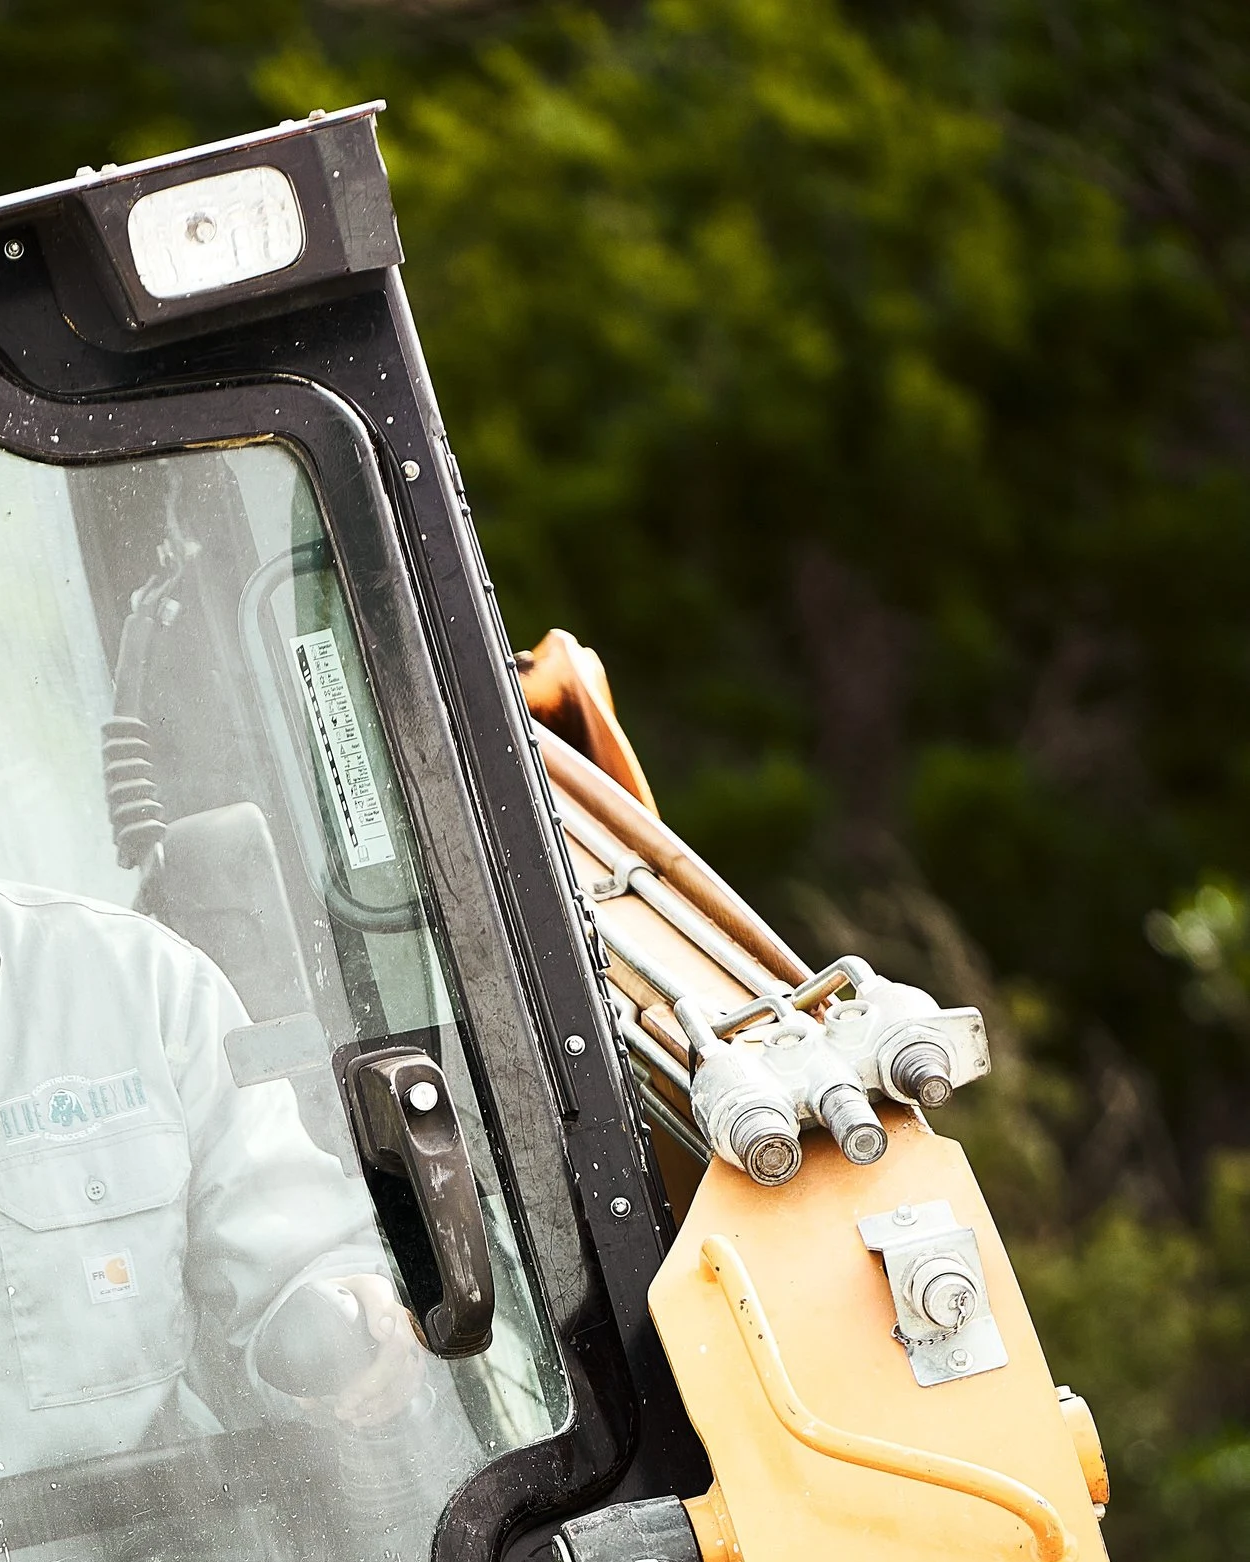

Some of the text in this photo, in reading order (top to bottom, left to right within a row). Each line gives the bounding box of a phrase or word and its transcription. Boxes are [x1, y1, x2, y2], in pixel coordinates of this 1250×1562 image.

[32, 1074, 92, 1098] CONSTRUCTION
[0, 1075, 147, 1138] BLUE BEXAR
[92, 1270, 106, 1281] FR
